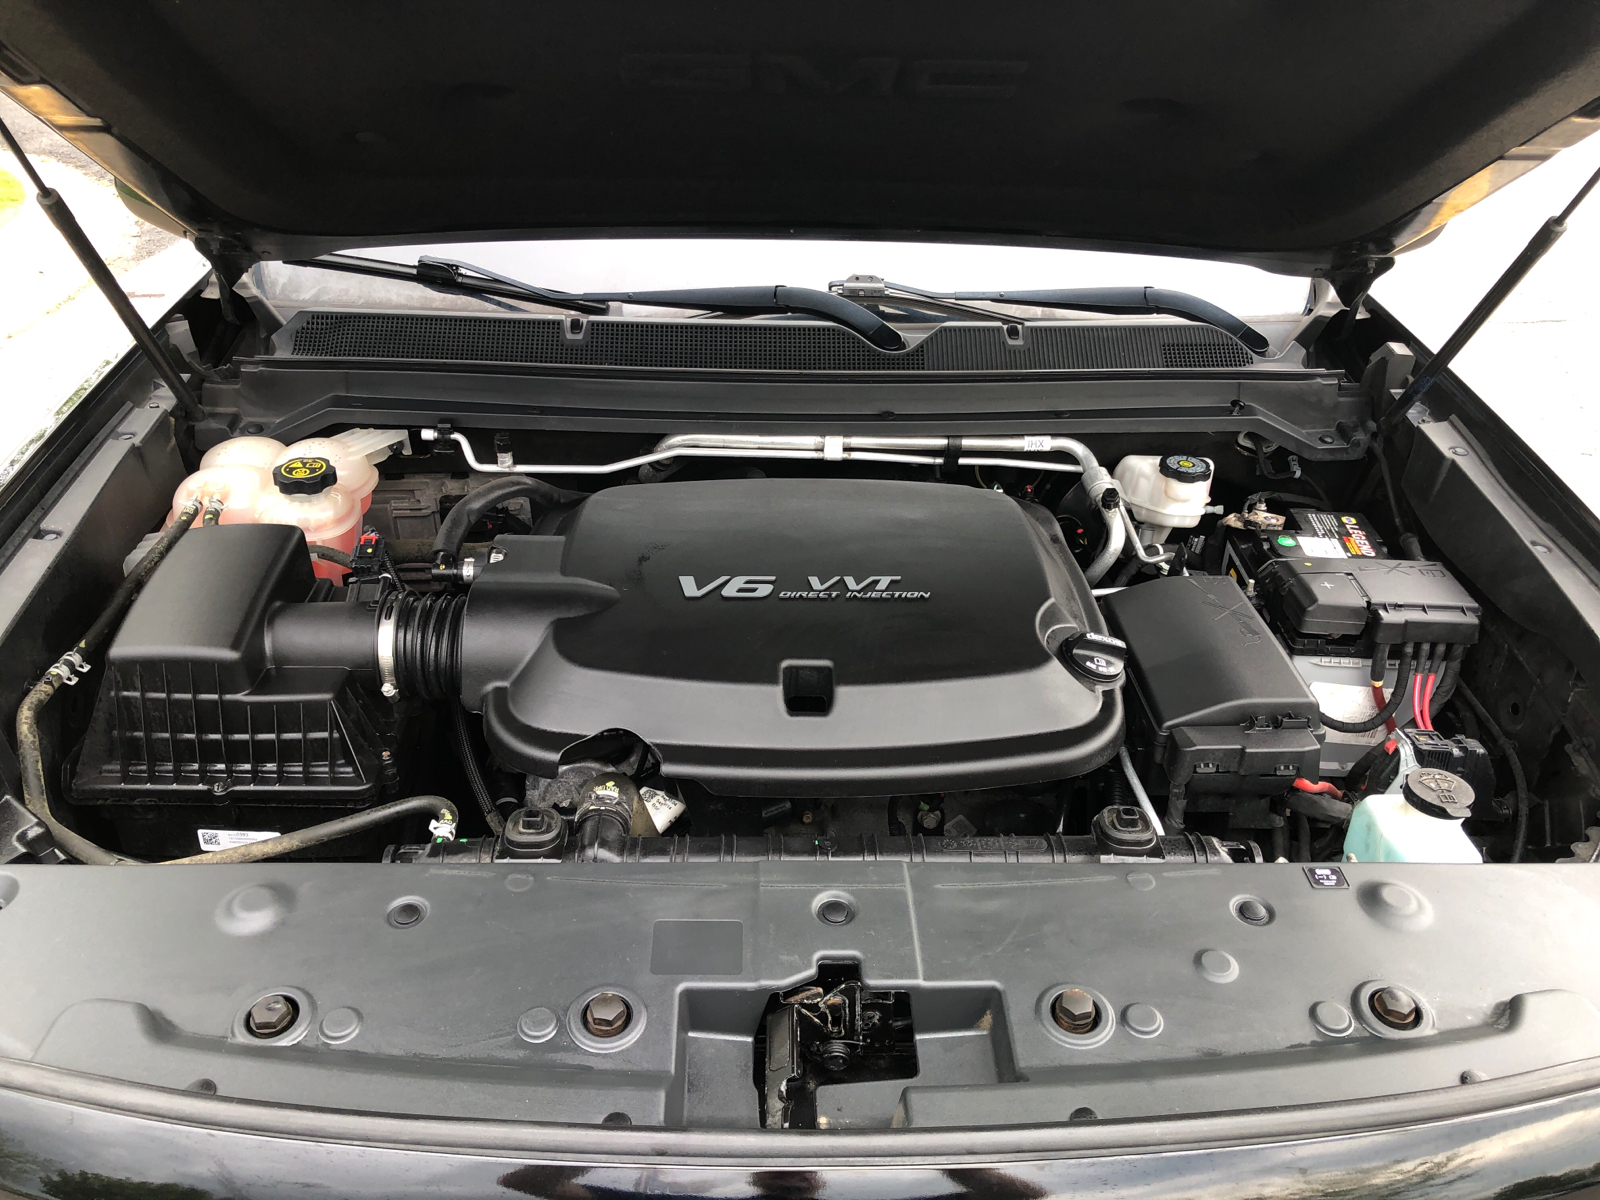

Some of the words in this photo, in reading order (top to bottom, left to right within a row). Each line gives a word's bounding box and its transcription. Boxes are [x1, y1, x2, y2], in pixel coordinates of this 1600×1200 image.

[618, 52, 1030, 99] GMC
[678, 575, 777, 598] V6
[807, 575, 902, 591] VVT
[778, 591, 841, 599] DIRECT
[845, 591, 931, 599] INJECTION
